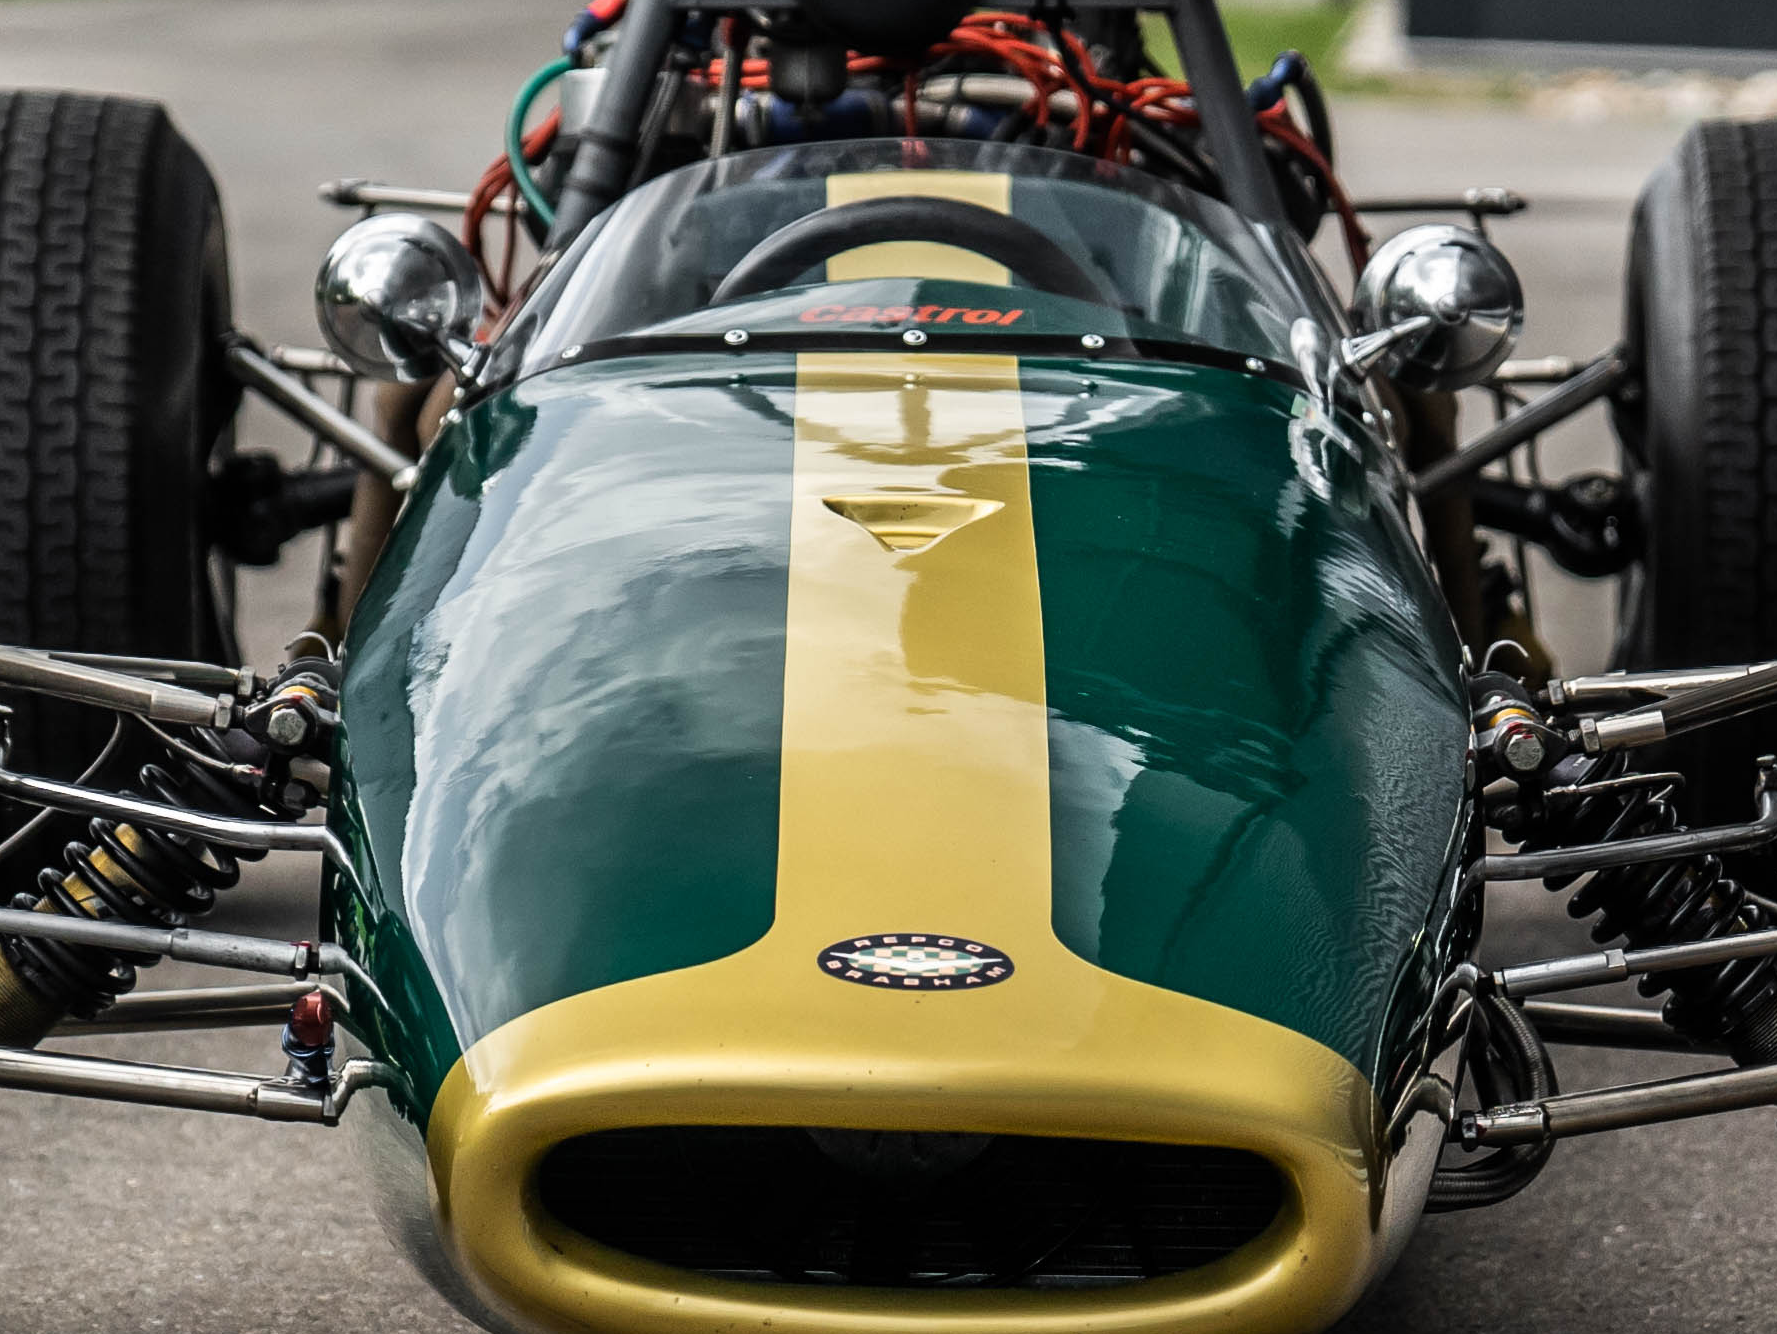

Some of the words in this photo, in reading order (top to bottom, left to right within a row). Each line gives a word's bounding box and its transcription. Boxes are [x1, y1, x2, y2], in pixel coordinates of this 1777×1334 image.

[799, 304, 1023, 325] Castrol
[854, 936, 983, 953] REPCO
[826, 960, 1006, 986] BRABHAM
